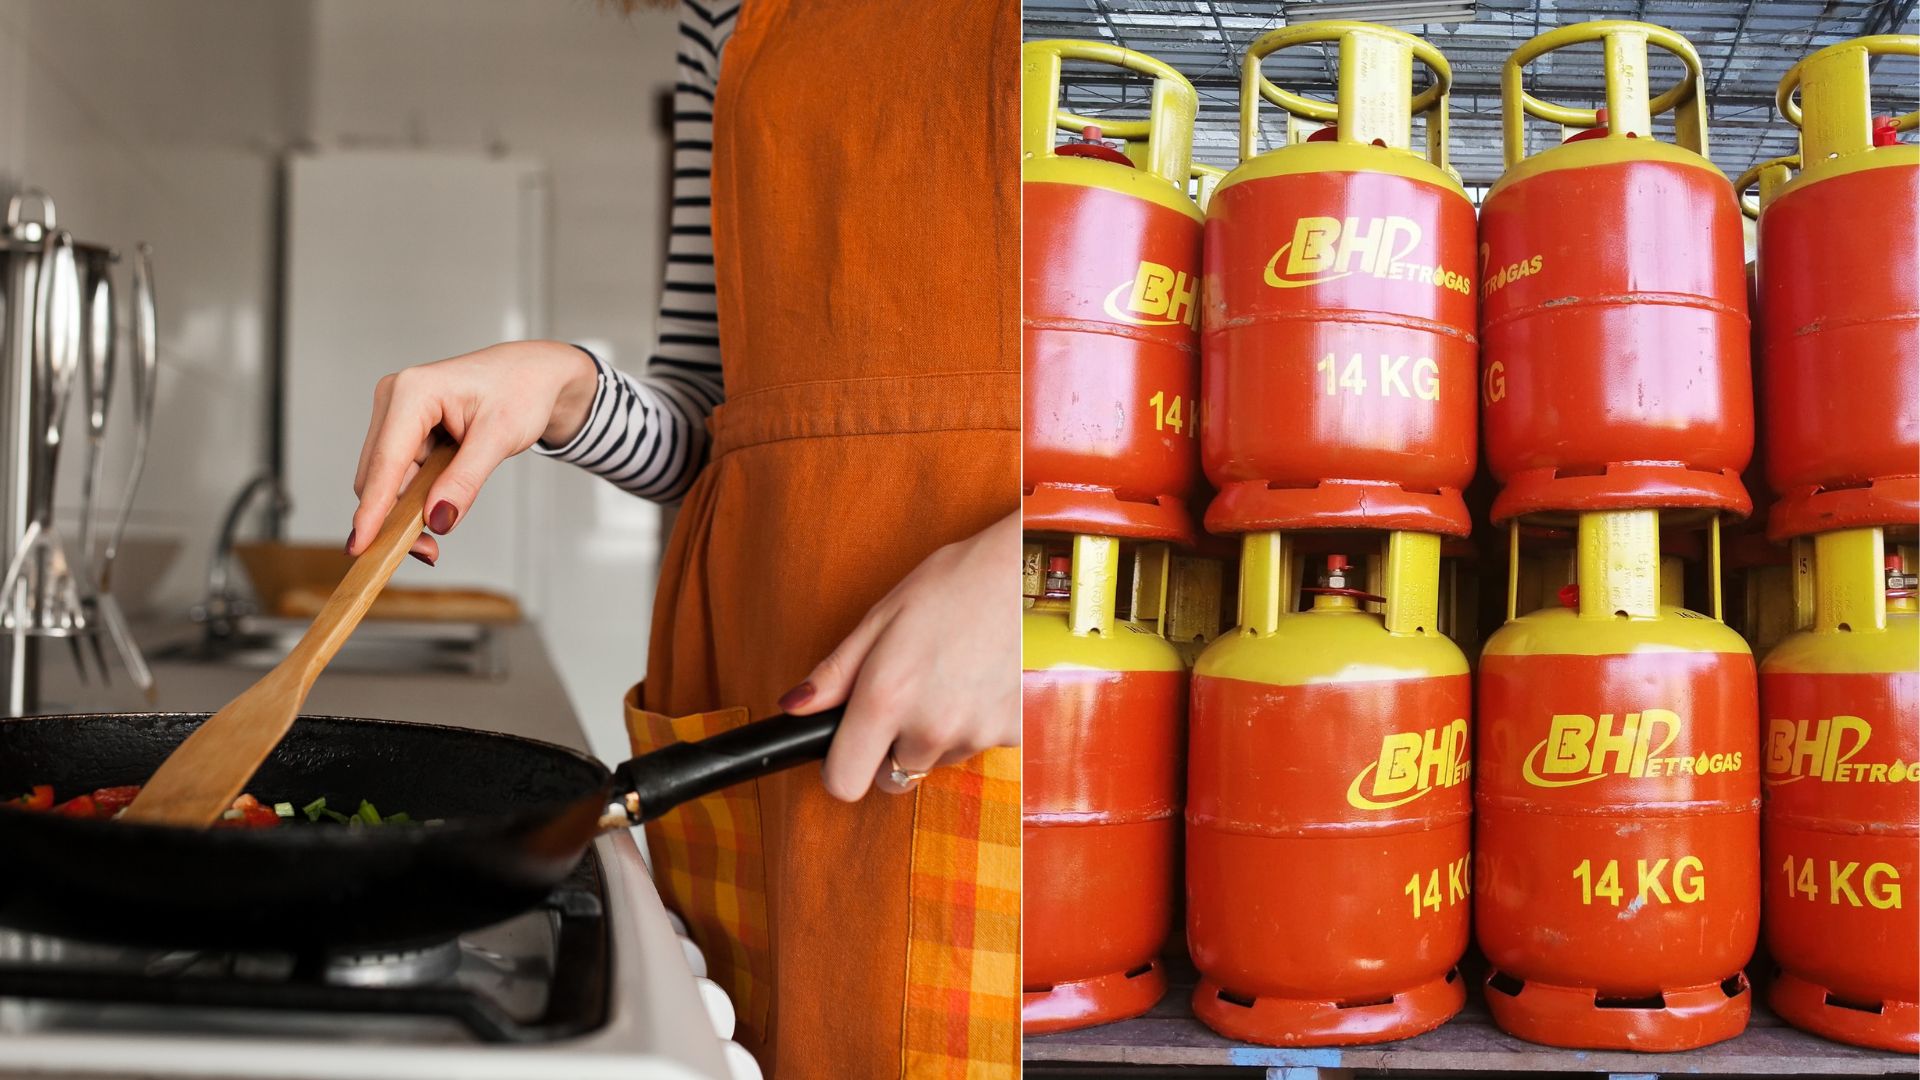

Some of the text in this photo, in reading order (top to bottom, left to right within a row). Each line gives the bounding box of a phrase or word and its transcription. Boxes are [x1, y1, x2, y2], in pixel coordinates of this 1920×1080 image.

[1317, 352, 1440, 401] 14 KG
[1149, 390, 1183, 435] 14
[1404, 867, 1443, 919] 14
[1572, 855, 1705, 907] 14 KG
[1782, 854, 1903, 910] 14 KG
